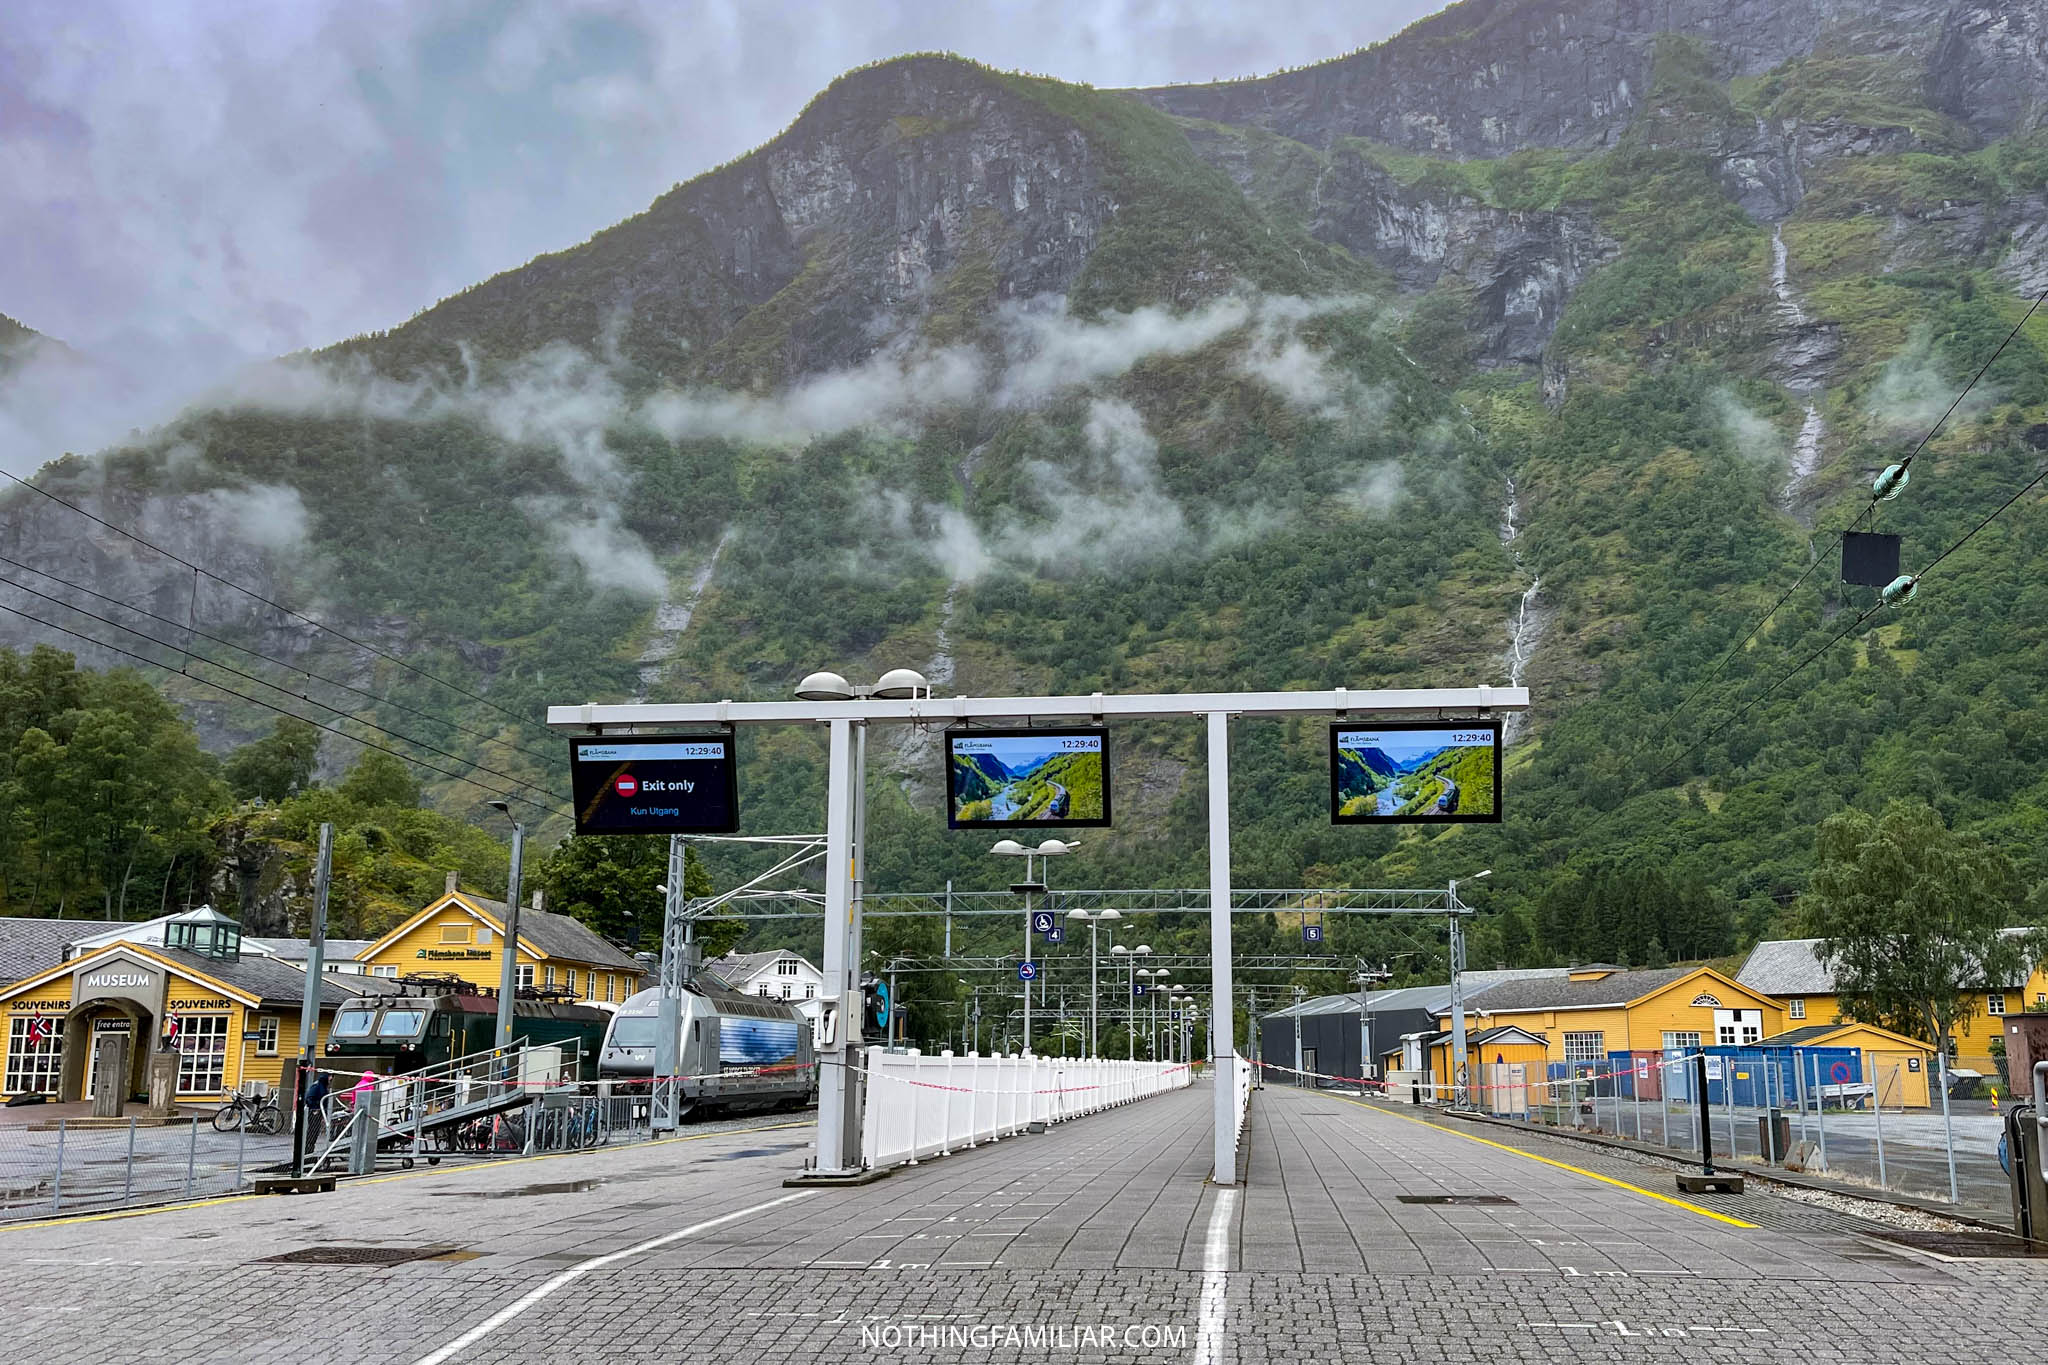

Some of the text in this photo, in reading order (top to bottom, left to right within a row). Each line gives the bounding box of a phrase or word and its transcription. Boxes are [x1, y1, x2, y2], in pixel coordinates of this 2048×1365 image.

[1452, 733, 1491, 742] 12:29:40
[1062, 739, 1099, 749] 12:29:40
[685, 747, 722, 755] 12:29:40
[642, 779, 695, 793] Exit only
[631, 807, 679, 817] Kun Utgang
[1051, 931, 1058, 939] 4
[1309, 929, 1317, 938] 5
[88, 974, 150, 988] MUSEUM
[12, 1000, 71, 1010] SOUVENIRS
[170, 999, 232, 1009] SOUVENIRS
[97, 1019, 111, 1030] free
